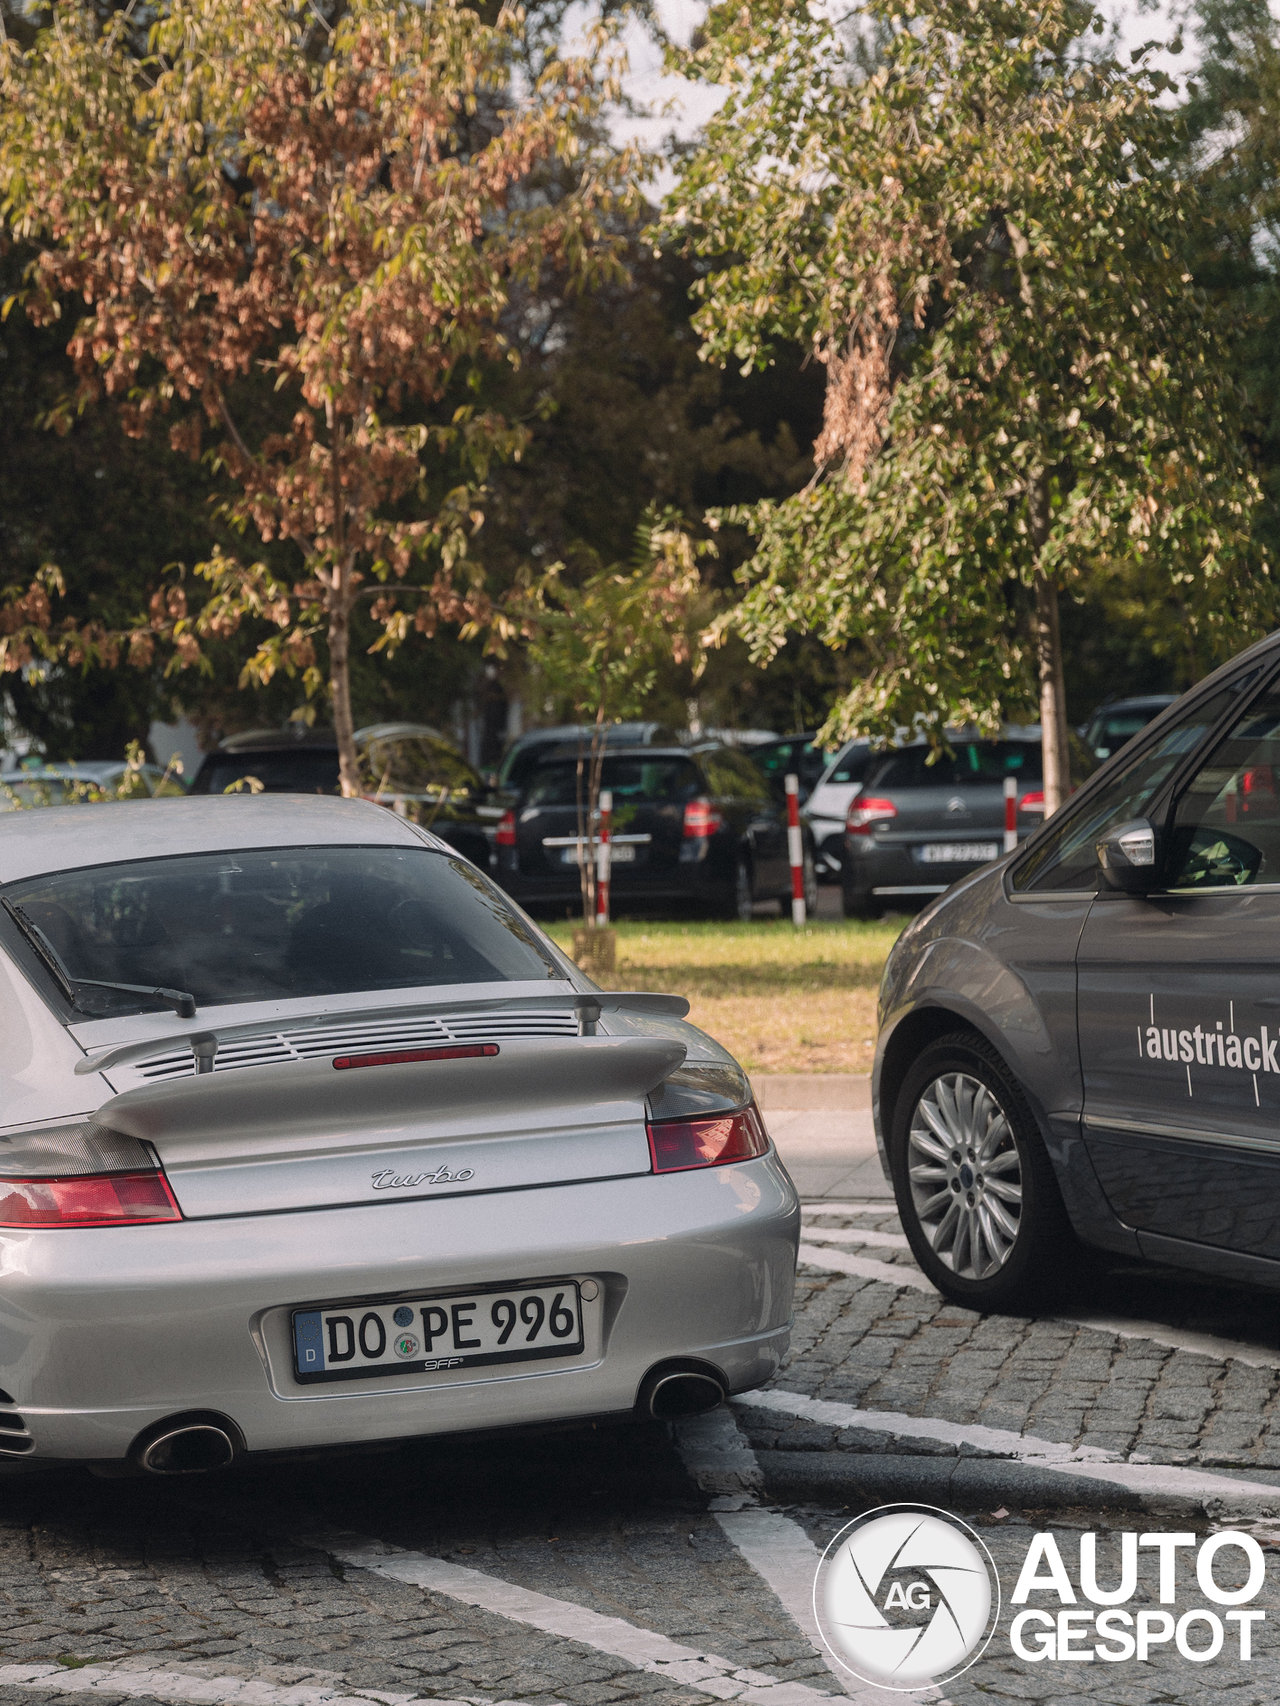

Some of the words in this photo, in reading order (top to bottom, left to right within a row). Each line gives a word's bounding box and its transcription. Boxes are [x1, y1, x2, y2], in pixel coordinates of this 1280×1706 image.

[1146, 1021, 1280, 1074] austriack
[372, 1165, 475, 1189] turbo
[325, 1311, 387, 1363] DO
[420, 1302, 481, 1353] PE
[491, 1293, 574, 1345] 996
[305, 1349, 316, 1361] D
